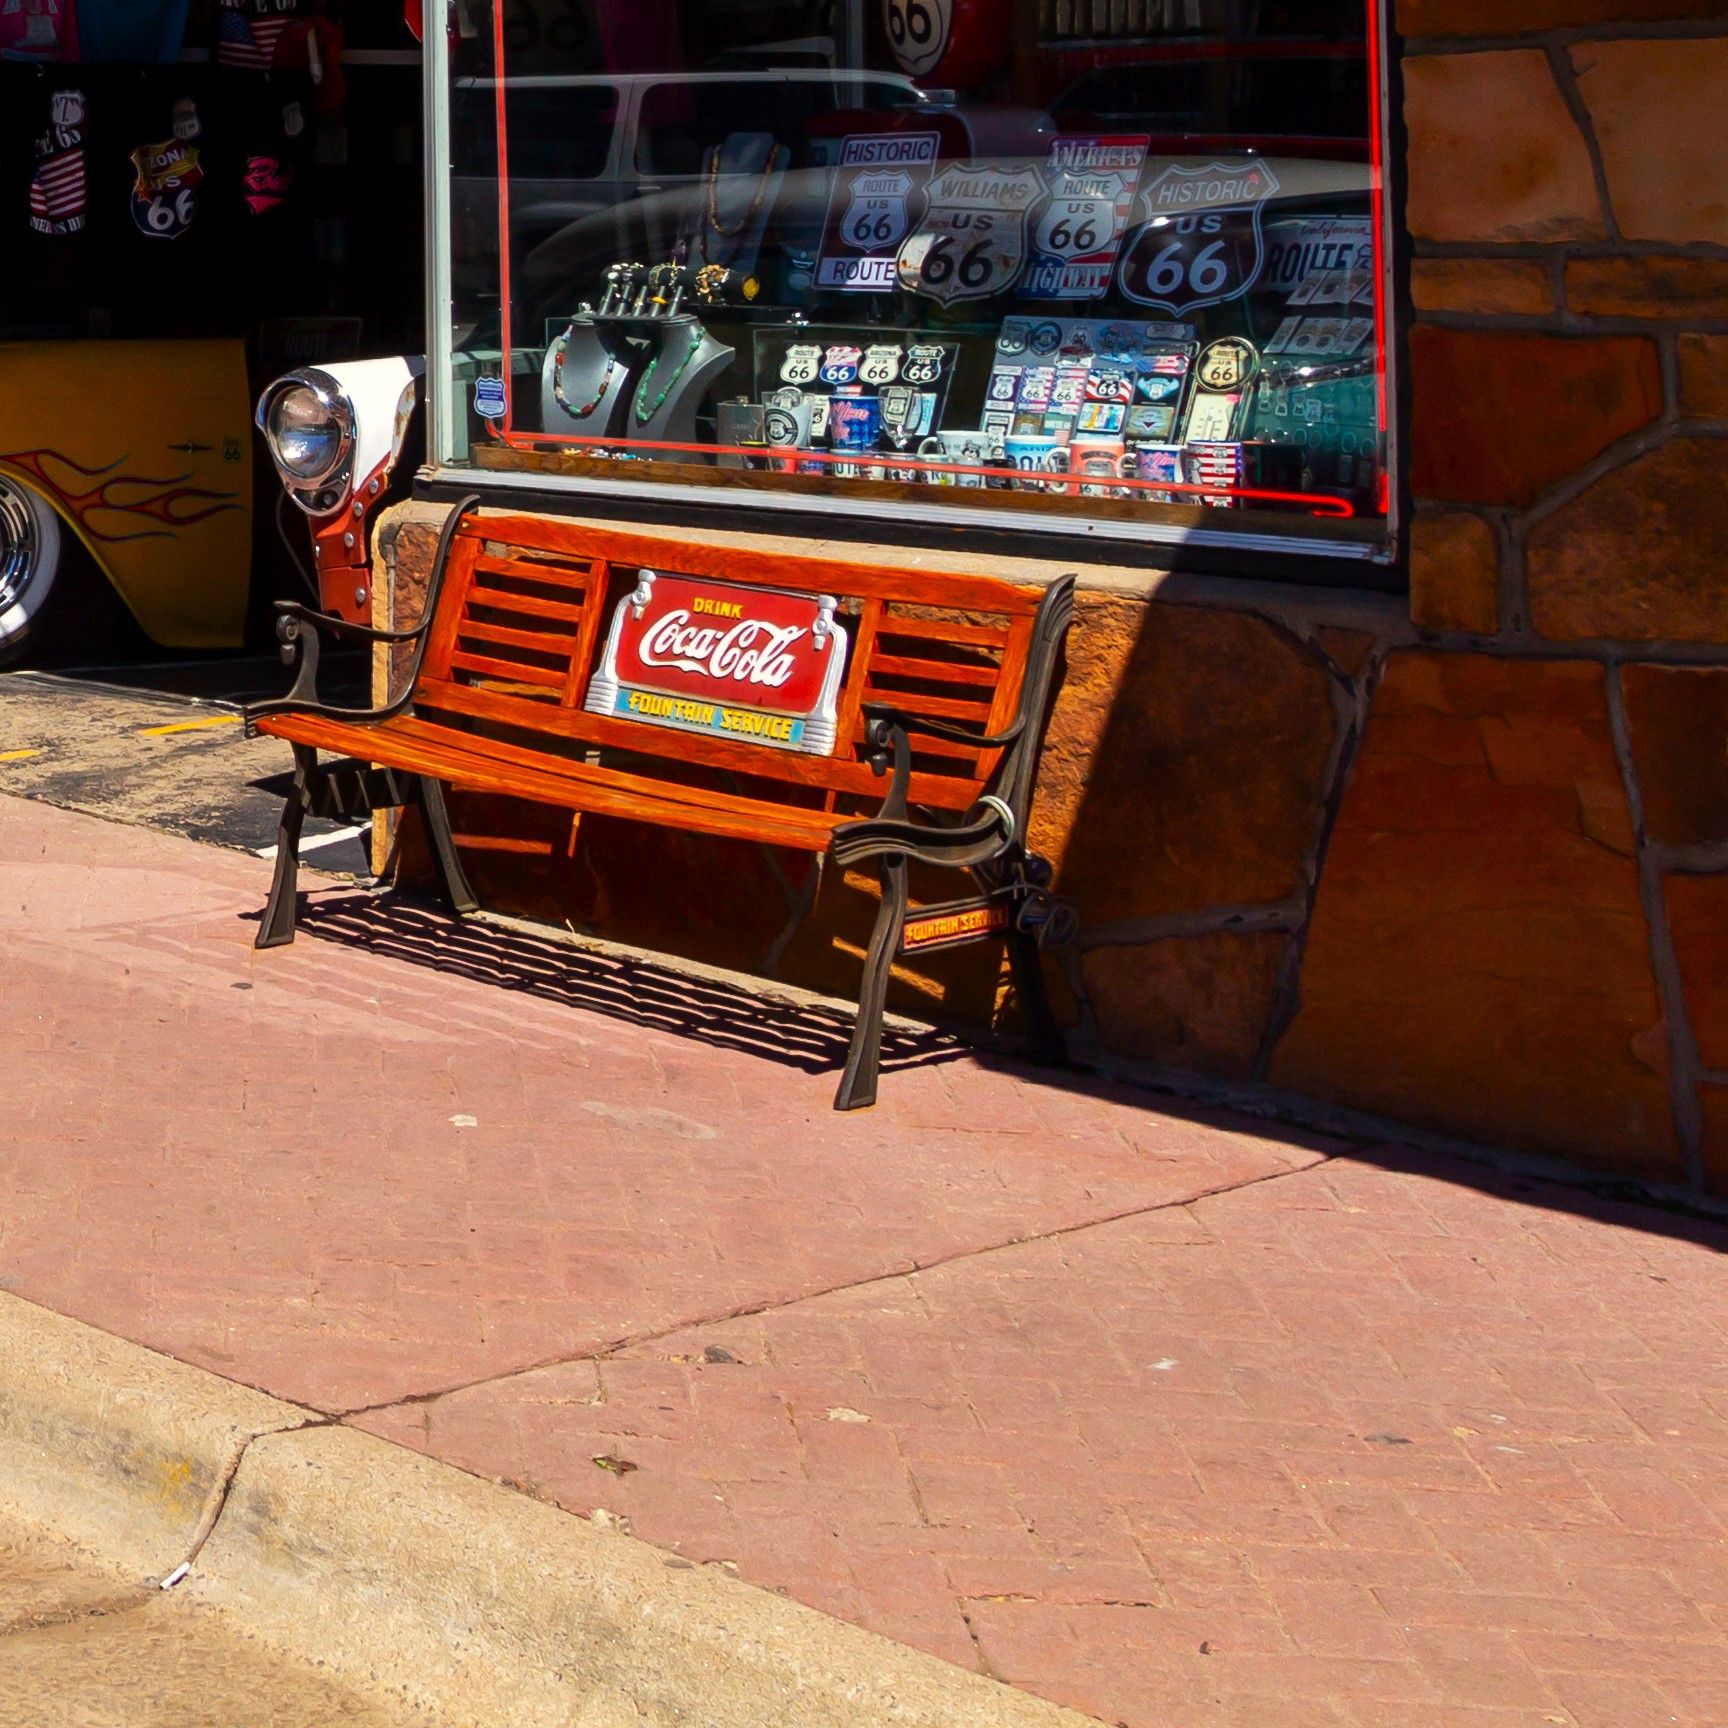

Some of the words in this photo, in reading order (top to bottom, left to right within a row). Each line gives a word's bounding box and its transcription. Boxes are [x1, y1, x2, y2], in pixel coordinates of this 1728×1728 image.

[845, 140, 932, 164] HISTORIC
[862, 177, 901, 193] ROUTE
[940, 180, 1029, 201] WILLIAMS
[1063, 179, 1112, 196] ROUTE
[1156, 178, 1260, 205] HISTORIC
[147, 188, 199, 231] 66
[866, 199, 890, 210] US
[1067, 202, 1095, 215] US
[853, 213, 893, 242] 66
[949, 212, 994, 231] US
[1175, 215, 1223, 234] US
[1048, 218, 1097, 251] 66
[920, 236, 995, 288] 66
[1146, 239, 1228, 295] 66
[832, 261, 895, 283] ROUTE
[788, 365, 810, 379] 66
[826, 366, 849, 380] 66
[867, 365, 889, 380] 66
[909, 365, 932, 379] 66
[1210, 366, 1232, 382] 66
[996, 385, 1012, 398] 66
[1025, 385, 1045, 399] 66
[1056, 389, 1072, 402] 66
[1097, 383, 1118, 397] 66
[692, 597, 744, 620] DRINK
[638, 608, 810, 688] Coca-Cola
[627, 690, 715, 727] FOUNTAIN
[720, 707, 794, 742] SERVICE
